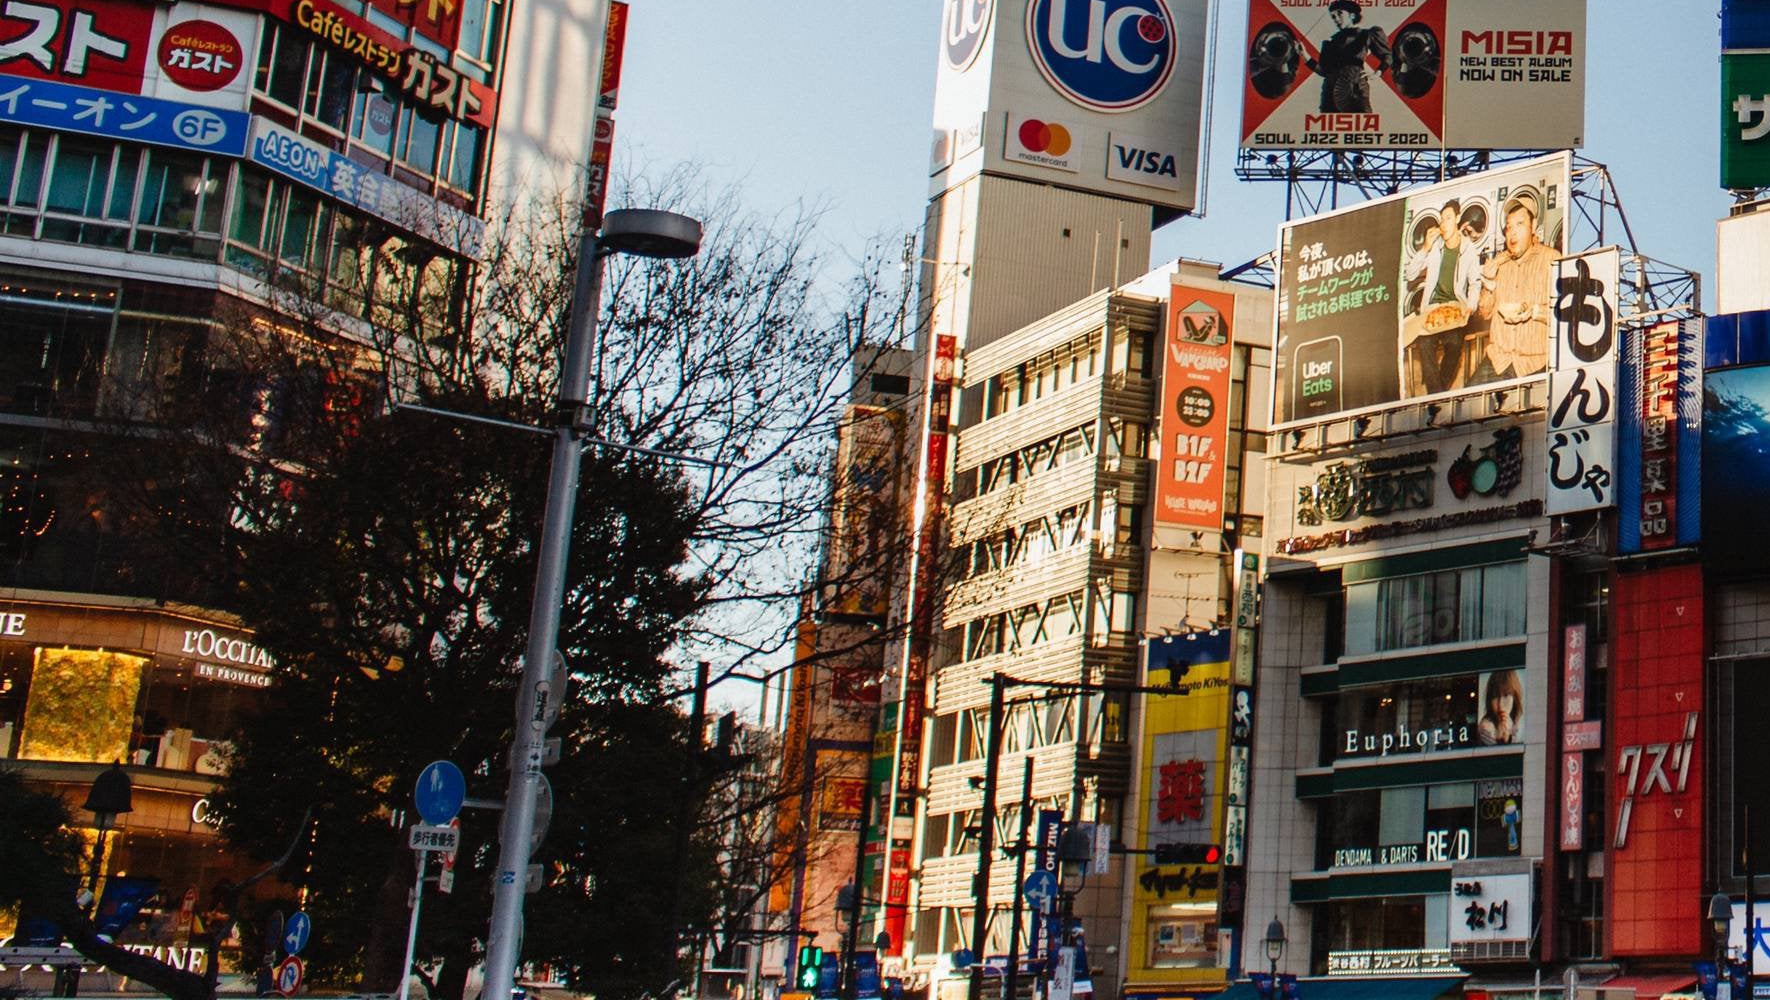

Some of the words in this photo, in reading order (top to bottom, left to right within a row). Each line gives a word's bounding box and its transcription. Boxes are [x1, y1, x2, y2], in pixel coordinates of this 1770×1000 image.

[1460, 30, 1573, 56] MISIA
[166, 46, 236, 75] ガスト
[1459, 56, 1487, 67] NEW
[1491, 56, 1525, 68] BEST
[1528, 56, 1573, 68] ALBUM
[1459, 68, 1496, 82] NOW
[1500, 68, 1524, 82] ON
[1528, 69, 1572, 82] SALE
[400, 49, 484, 121] ガスト
[0, 83, 158, 131] イーオン
[178, 115, 222, 141] 6F
[1304, 113, 1381, 132] MISIA
[262, 131, 320, 177] AEON
[1254, 133, 1296, 145] SOUL
[1300, 133, 1340, 145] JAZZ
[1343, 133, 1384, 145] BEST
[1389, 132, 1429, 145] 2020
[1018, 152, 1068, 168] mastercard
[1114, 145, 1178, 178] VISA
[1296, 266, 1375, 302] チームワークが
[1302, 359, 1333, 380] Uber
[1548, 257, 1614, 504] もんじゃ
[1301, 377, 1334, 398] Eats
[182, 629, 277, 669] L'OCCITA
[1344, 720, 1470, 757] Euphoria
[1157, 759, 1206, 825] 薬
[1612, 711, 1700, 850] クスリ
[1045, 822, 1059, 872] MIZHO
[1389, 845, 1419, 864] DARTS
[1425, 828, 1471, 863] RE/D
